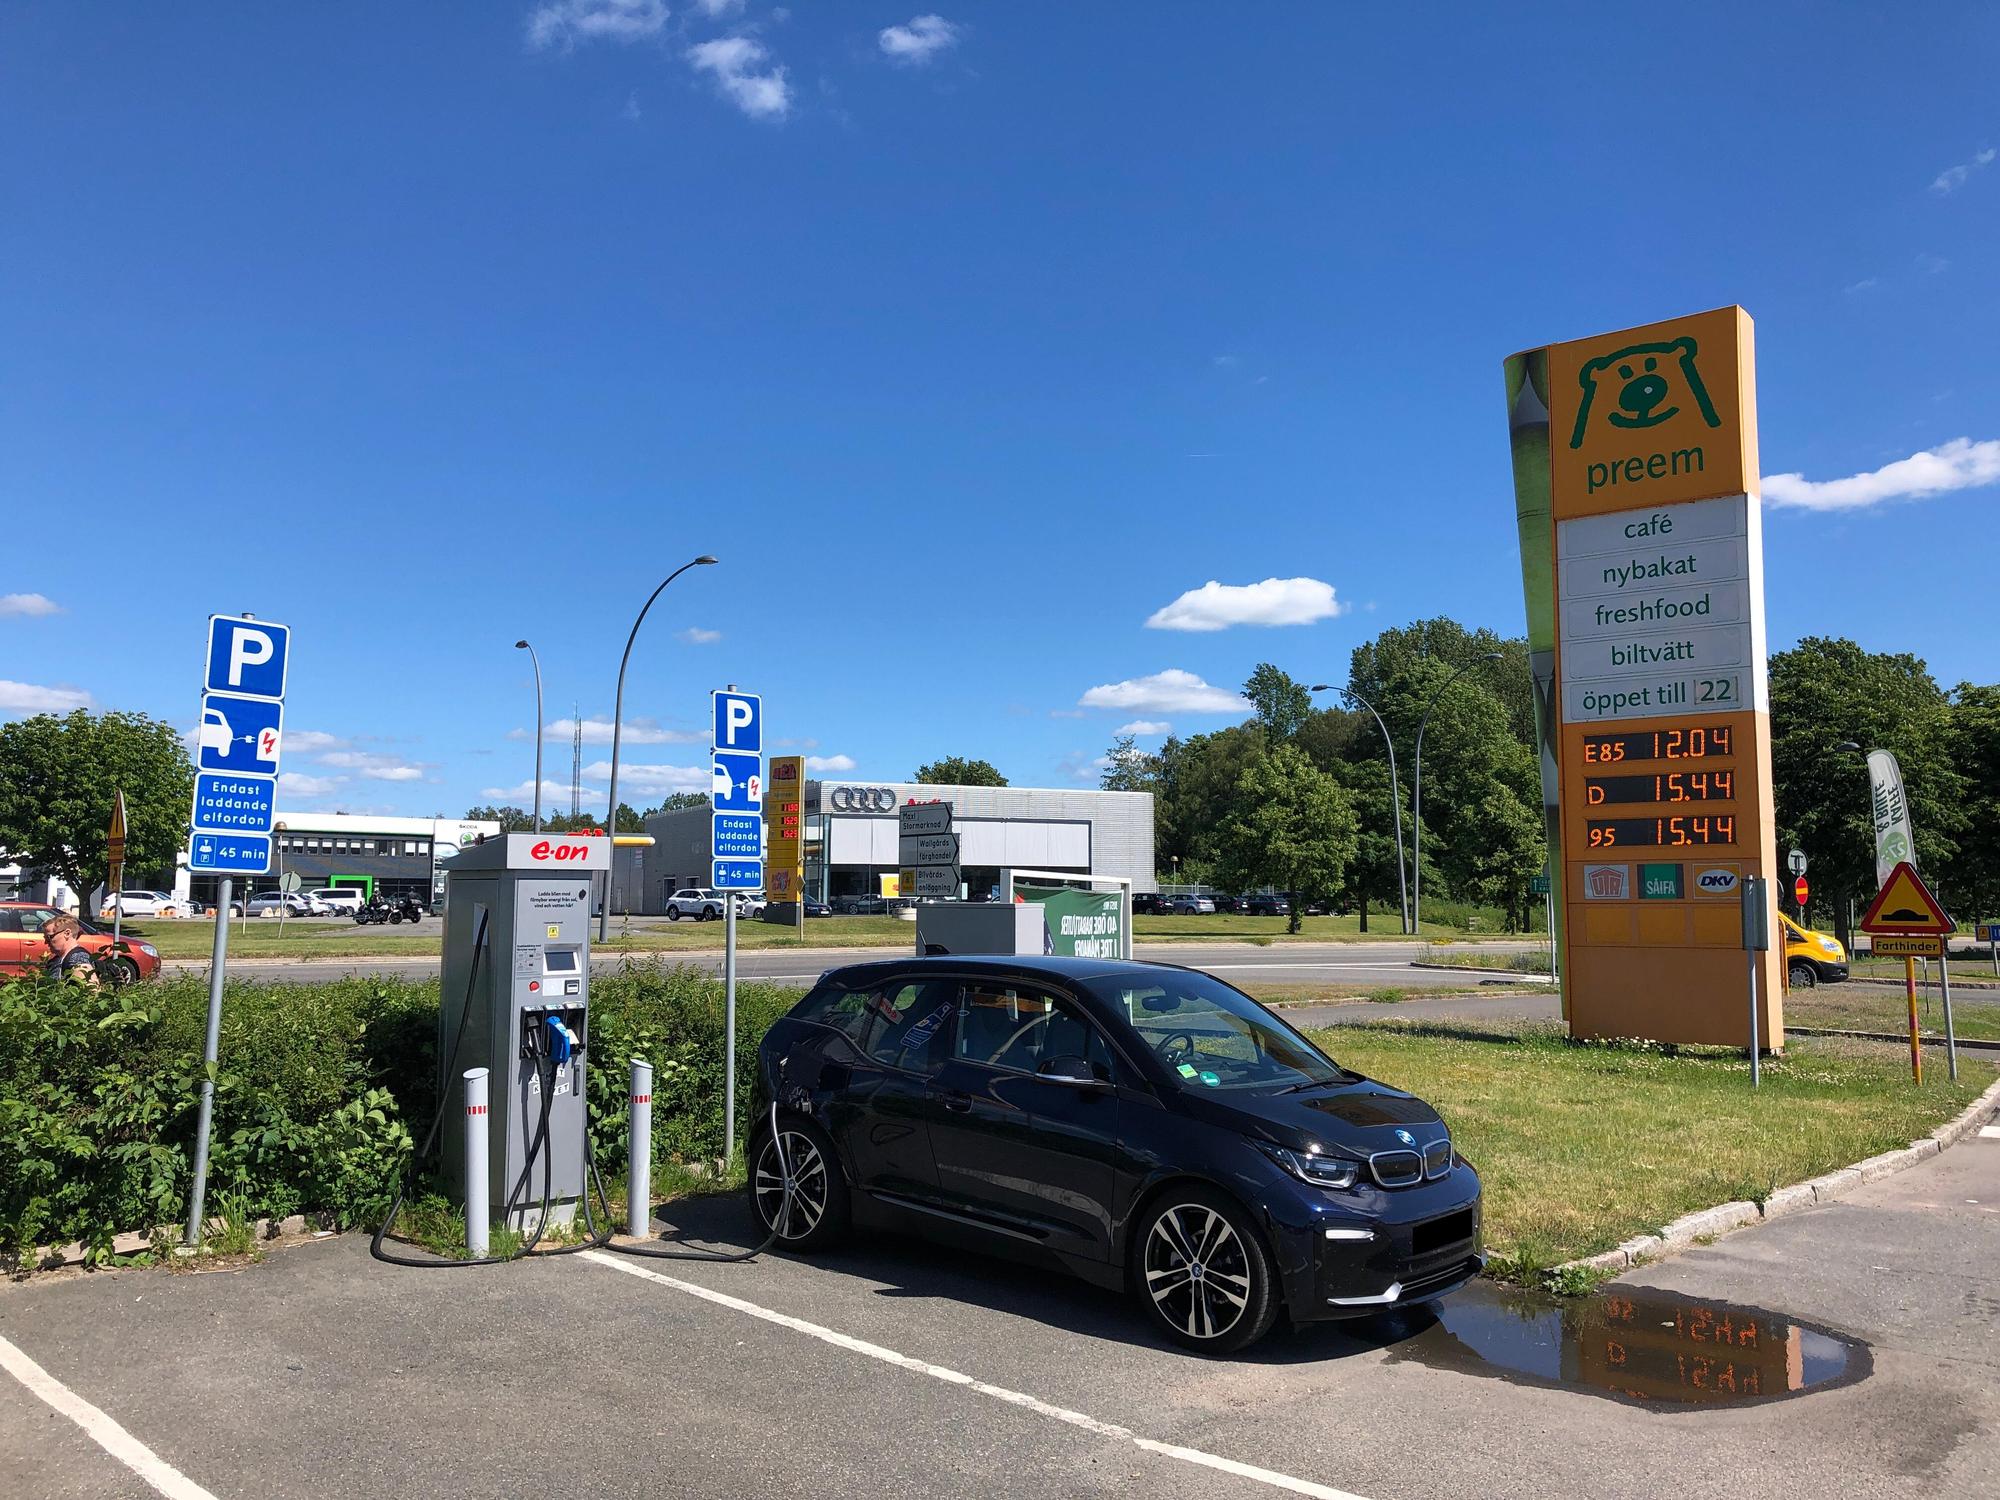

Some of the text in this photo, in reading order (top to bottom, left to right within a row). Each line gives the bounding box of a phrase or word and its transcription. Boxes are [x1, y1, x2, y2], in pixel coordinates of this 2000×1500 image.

[1588, 447, 1703, 494] preem
[1624, 514, 1673, 539] café
[1603, 555, 1697, 588] nybakat
[1595, 593, 1710, 626] freshfood
[228, 626, 274, 686] P
[1611, 640, 1695, 666] biltvätt
[1583, 679, 1732, 715] öppet till 22
[727, 698, 753, 744] P
[1584, 728, 1729, 763] E85 12.04
[212, 781, 260, 796] Endast
[1588, 772, 1731, 805] D 15.44
[201, 796, 268, 811] laddande
[202, 811, 265, 826] elfordon
[723, 819, 752, 829] Endast
[903, 821, 941, 830] Stormarknad
[716, 831, 758, 841] laddande
[1589, 816, 1733, 847] 95 15.44
[219, 847, 237, 858] 45
[242, 847, 266, 860] min
[718, 843, 757, 852] elfordon
[730, 870, 742, 879] 45
[745, 870, 760, 879] min
[1700, 875, 1735, 887] DKV
[1876, 940, 1938, 951] Farthinder
